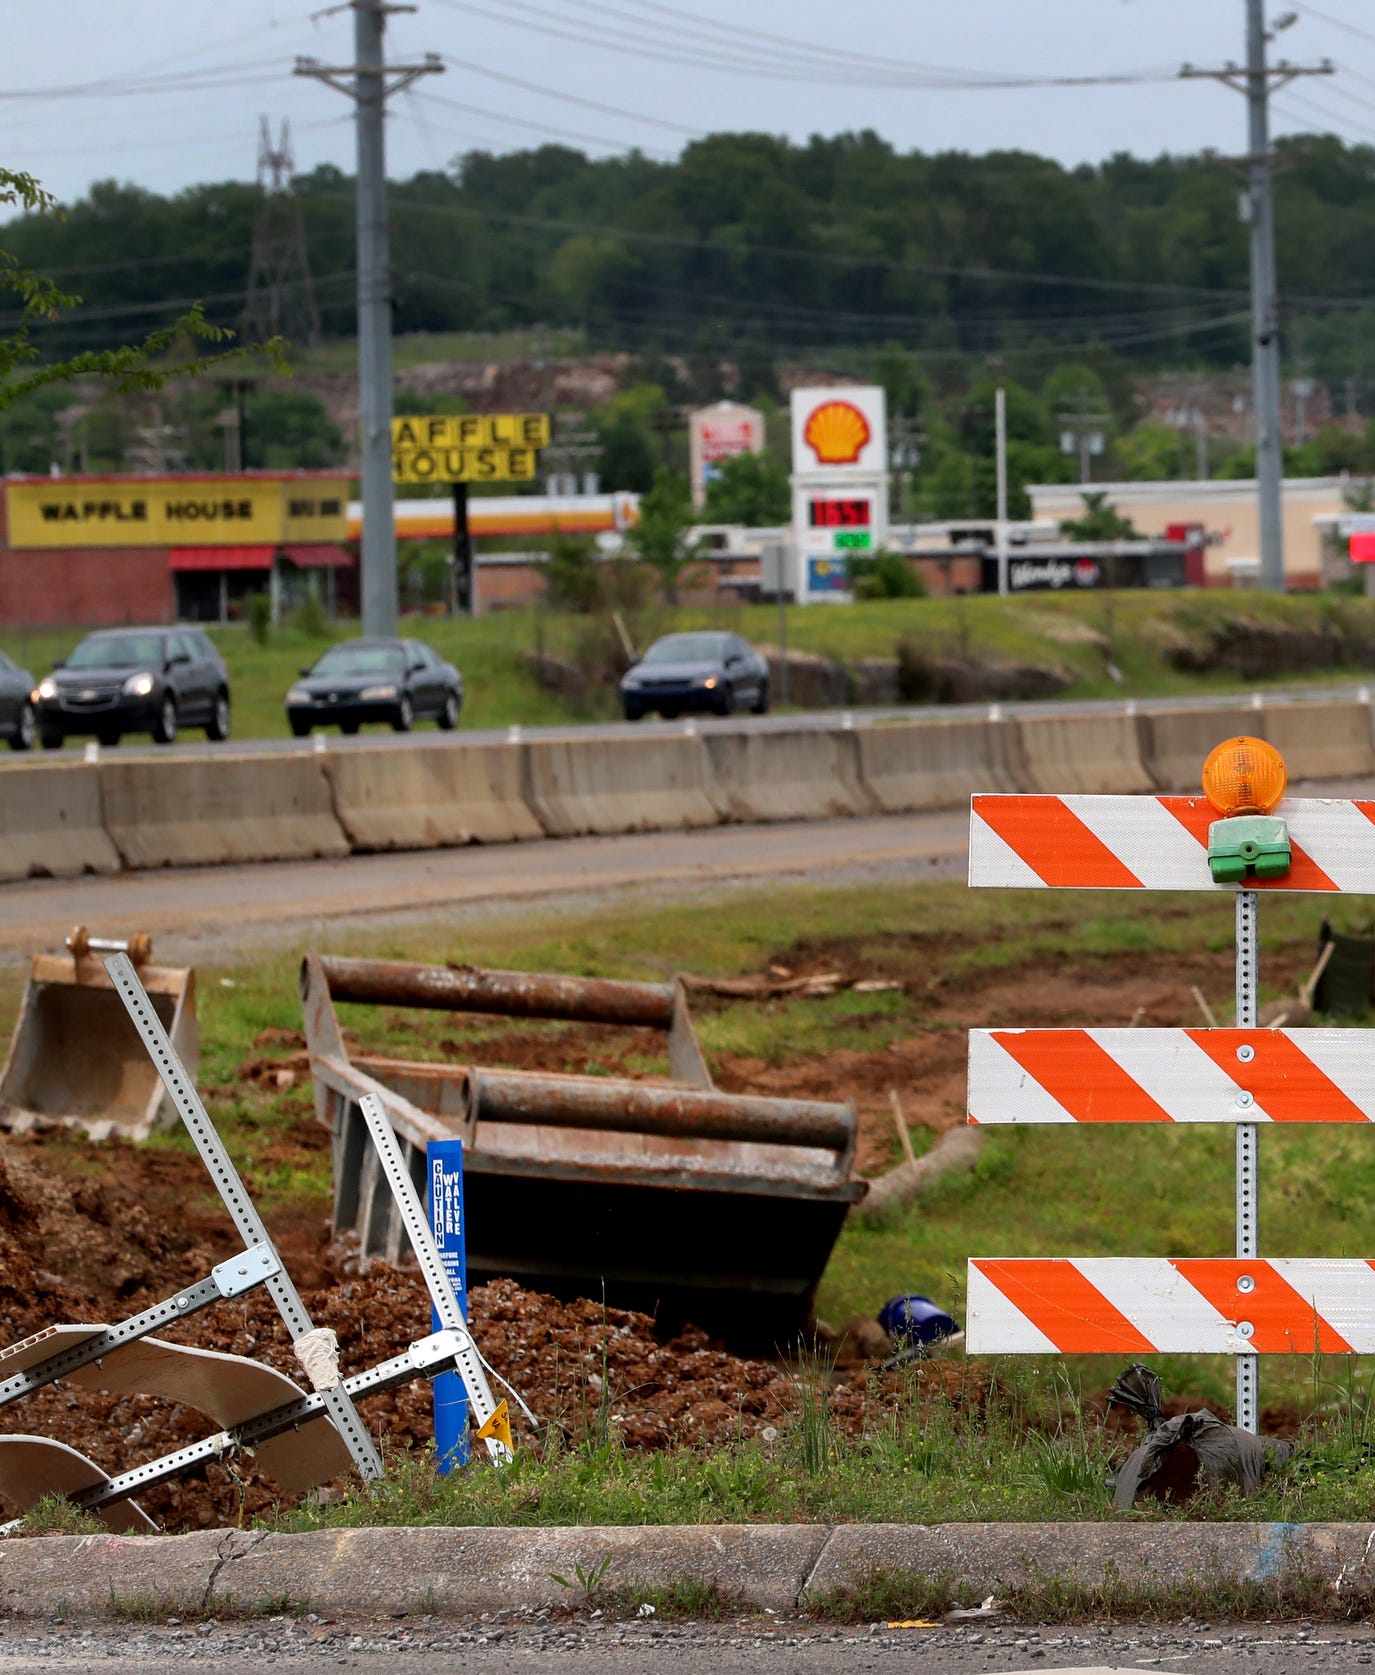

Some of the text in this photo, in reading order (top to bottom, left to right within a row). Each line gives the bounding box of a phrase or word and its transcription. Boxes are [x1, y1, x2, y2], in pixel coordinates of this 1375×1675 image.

[397, 416, 543, 446] AFFLE
[40, 499, 253, 522] WAFFLE HOUSE
[434, 1162, 443, 1246] CAUTION
[443, 1173, 454, 1234] WATER
[453, 1171, 461, 1236] VALVE
[446, 1268, 456, 1276] ALL
